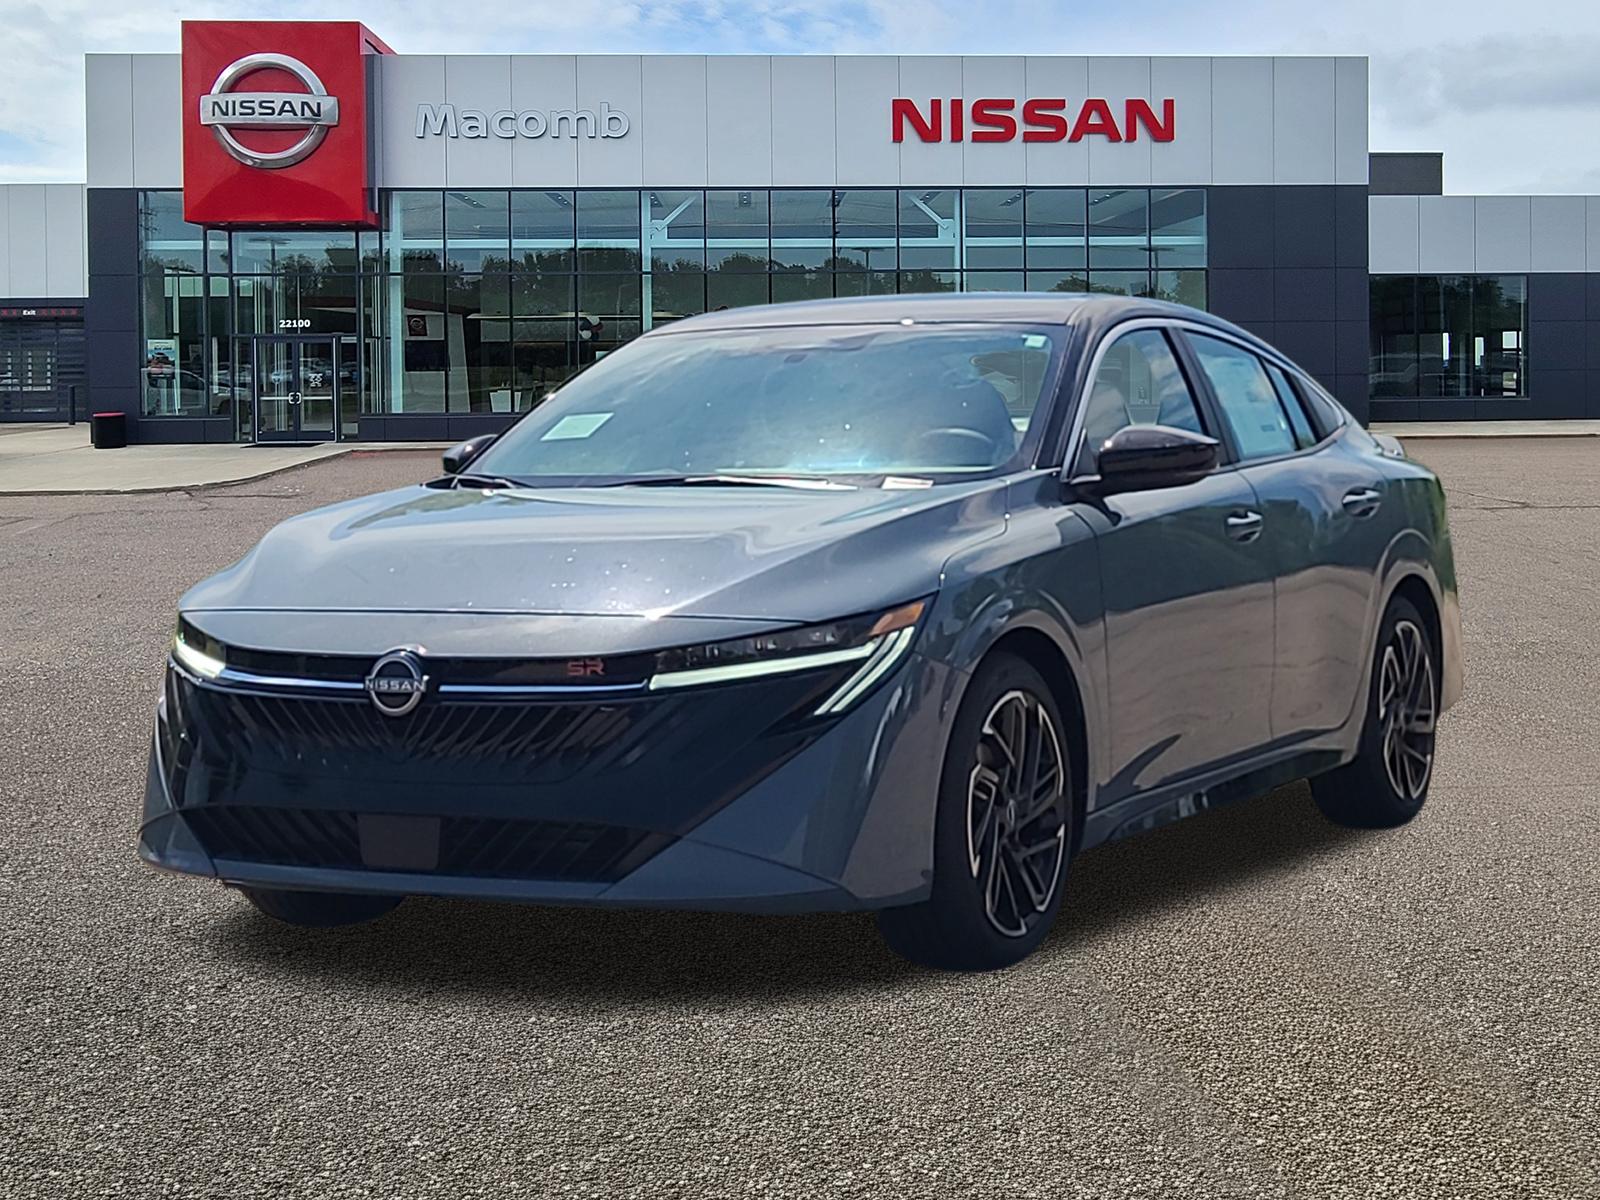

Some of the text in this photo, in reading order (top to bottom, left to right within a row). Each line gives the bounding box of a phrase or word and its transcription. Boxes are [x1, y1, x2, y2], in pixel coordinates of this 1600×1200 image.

[212, 100, 322, 117] NISSAN
[415, 102, 630, 139] Macomb
[892, 98, 1175, 143] NISSAN
[279, 319, 311, 328] 22100
[567, 657, 606, 676] SR
[365, 677, 427, 692] NISSAN
